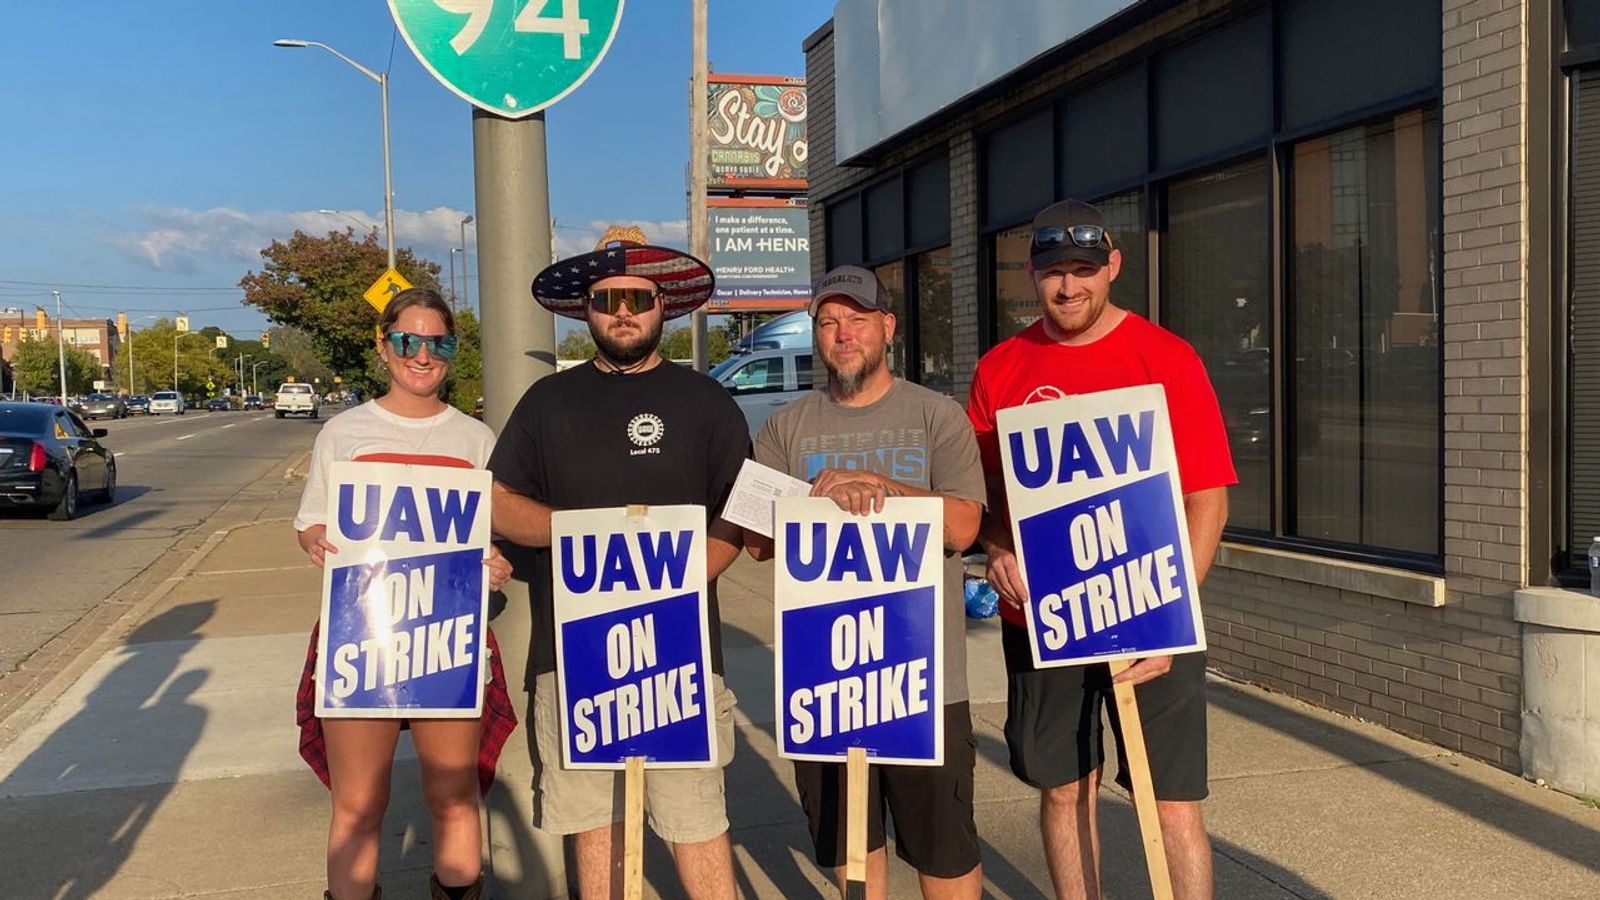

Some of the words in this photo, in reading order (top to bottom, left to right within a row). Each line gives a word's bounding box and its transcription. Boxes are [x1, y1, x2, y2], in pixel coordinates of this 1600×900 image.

[711, 89, 787, 177] Stay
[714, 215, 719, 224] I
[720, 215, 740, 224] make
[747, 215, 789, 225] difference,
[715, 237, 721, 252] I
[725, 237, 753, 252] AM
[756, 237, 809, 252] HENR
[731, 226, 759, 236] patient
[760, 226, 769, 234] at
[775, 226, 796, 234] time.
[716, 266, 742, 274] HENRY
[743, 266, 764, 274] FORD
[765, 266, 796, 274] HEALTH
[738, 289, 762, 297] Delivery
[629, 448, 647, 456] Local
[1008, 410, 1155, 489] UAW
[338, 483, 482, 544] UAW
[1069, 499, 1128, 572] ON
[560, 530, 694, 594] UAW
[785, 522, 931, 582] UAW
[384, 564, 436, 627] ON
[1038, 543, 1183, 651] STRIKE
[332, 613, 475, 699] STRIKE
[606, 613, 657, 680] ON
[831, 606, 884, 672] ON
[573, 662, 701, 754] STRIKE
[789, 657, 929, 744] STRIKE
